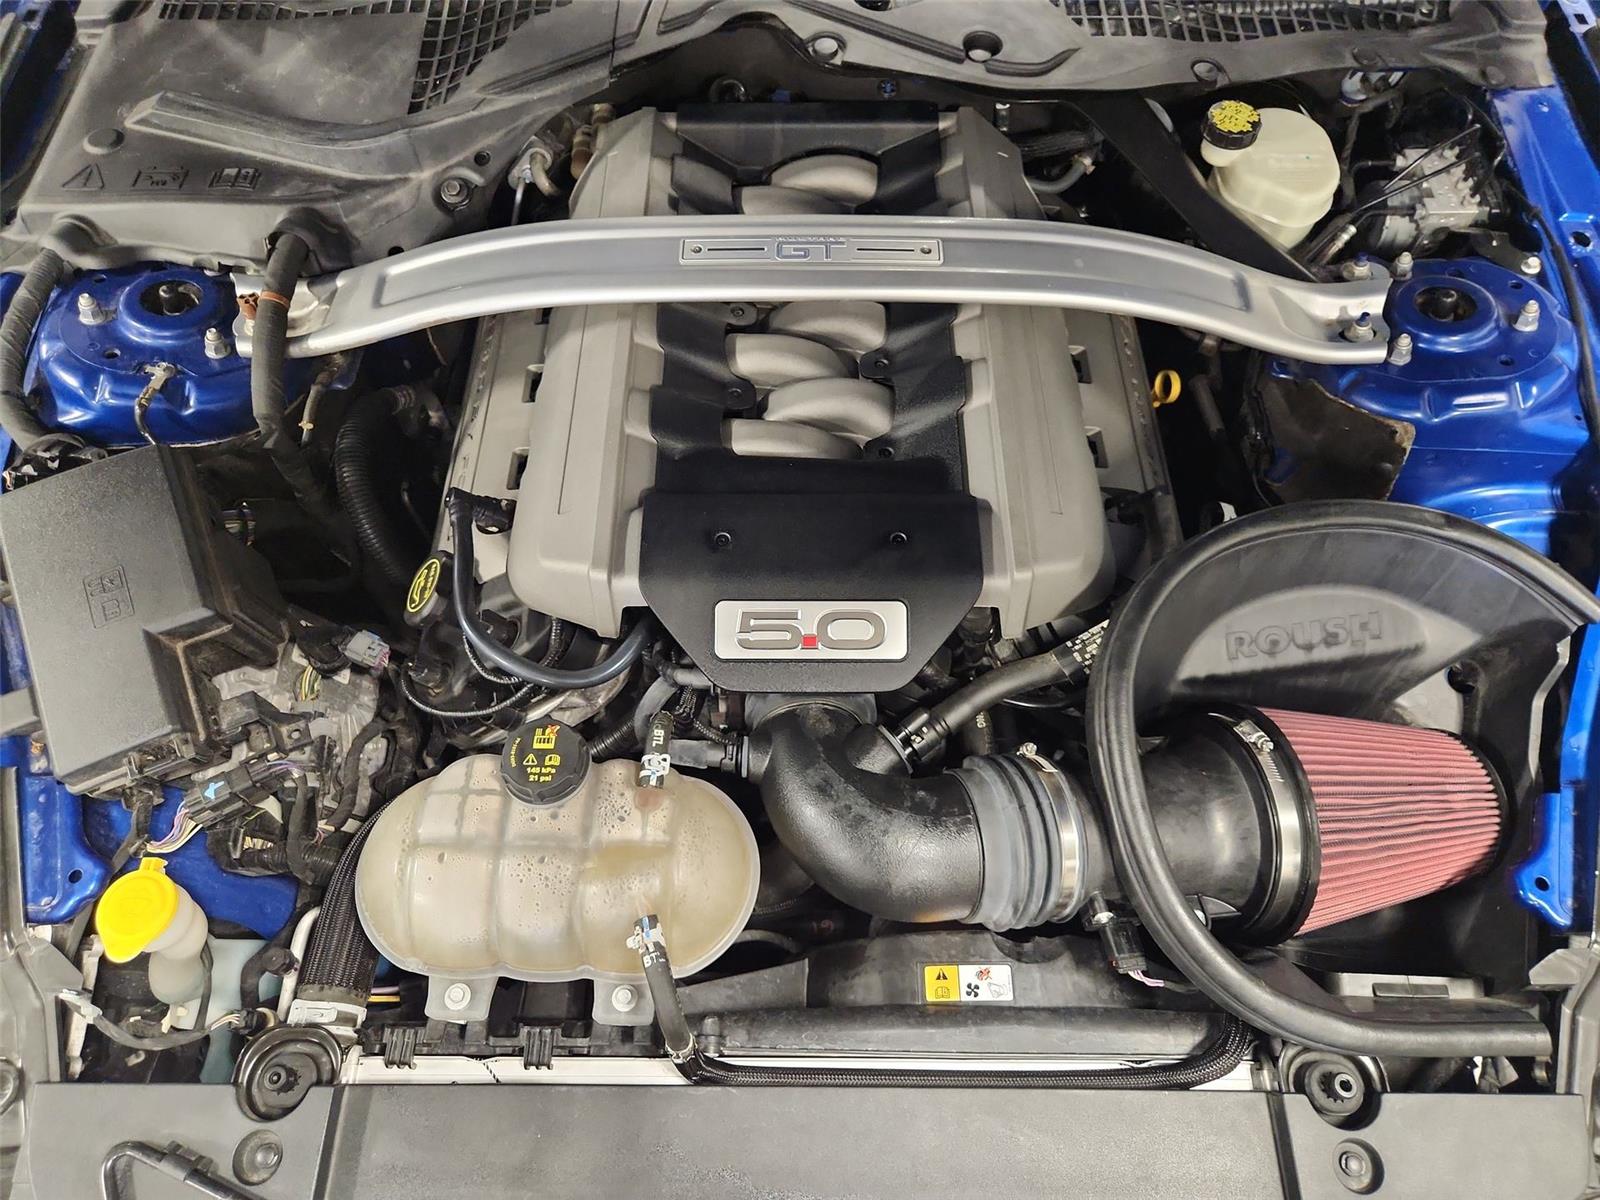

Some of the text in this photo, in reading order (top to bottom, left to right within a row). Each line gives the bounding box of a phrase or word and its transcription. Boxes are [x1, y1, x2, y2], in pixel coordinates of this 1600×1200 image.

[775, 240, 847, 261] GT
[735, 608, 887, 651] 5.0
[1225, 610, 1382, 661] ROUSH
[652, 729, 665, 748] BTL
